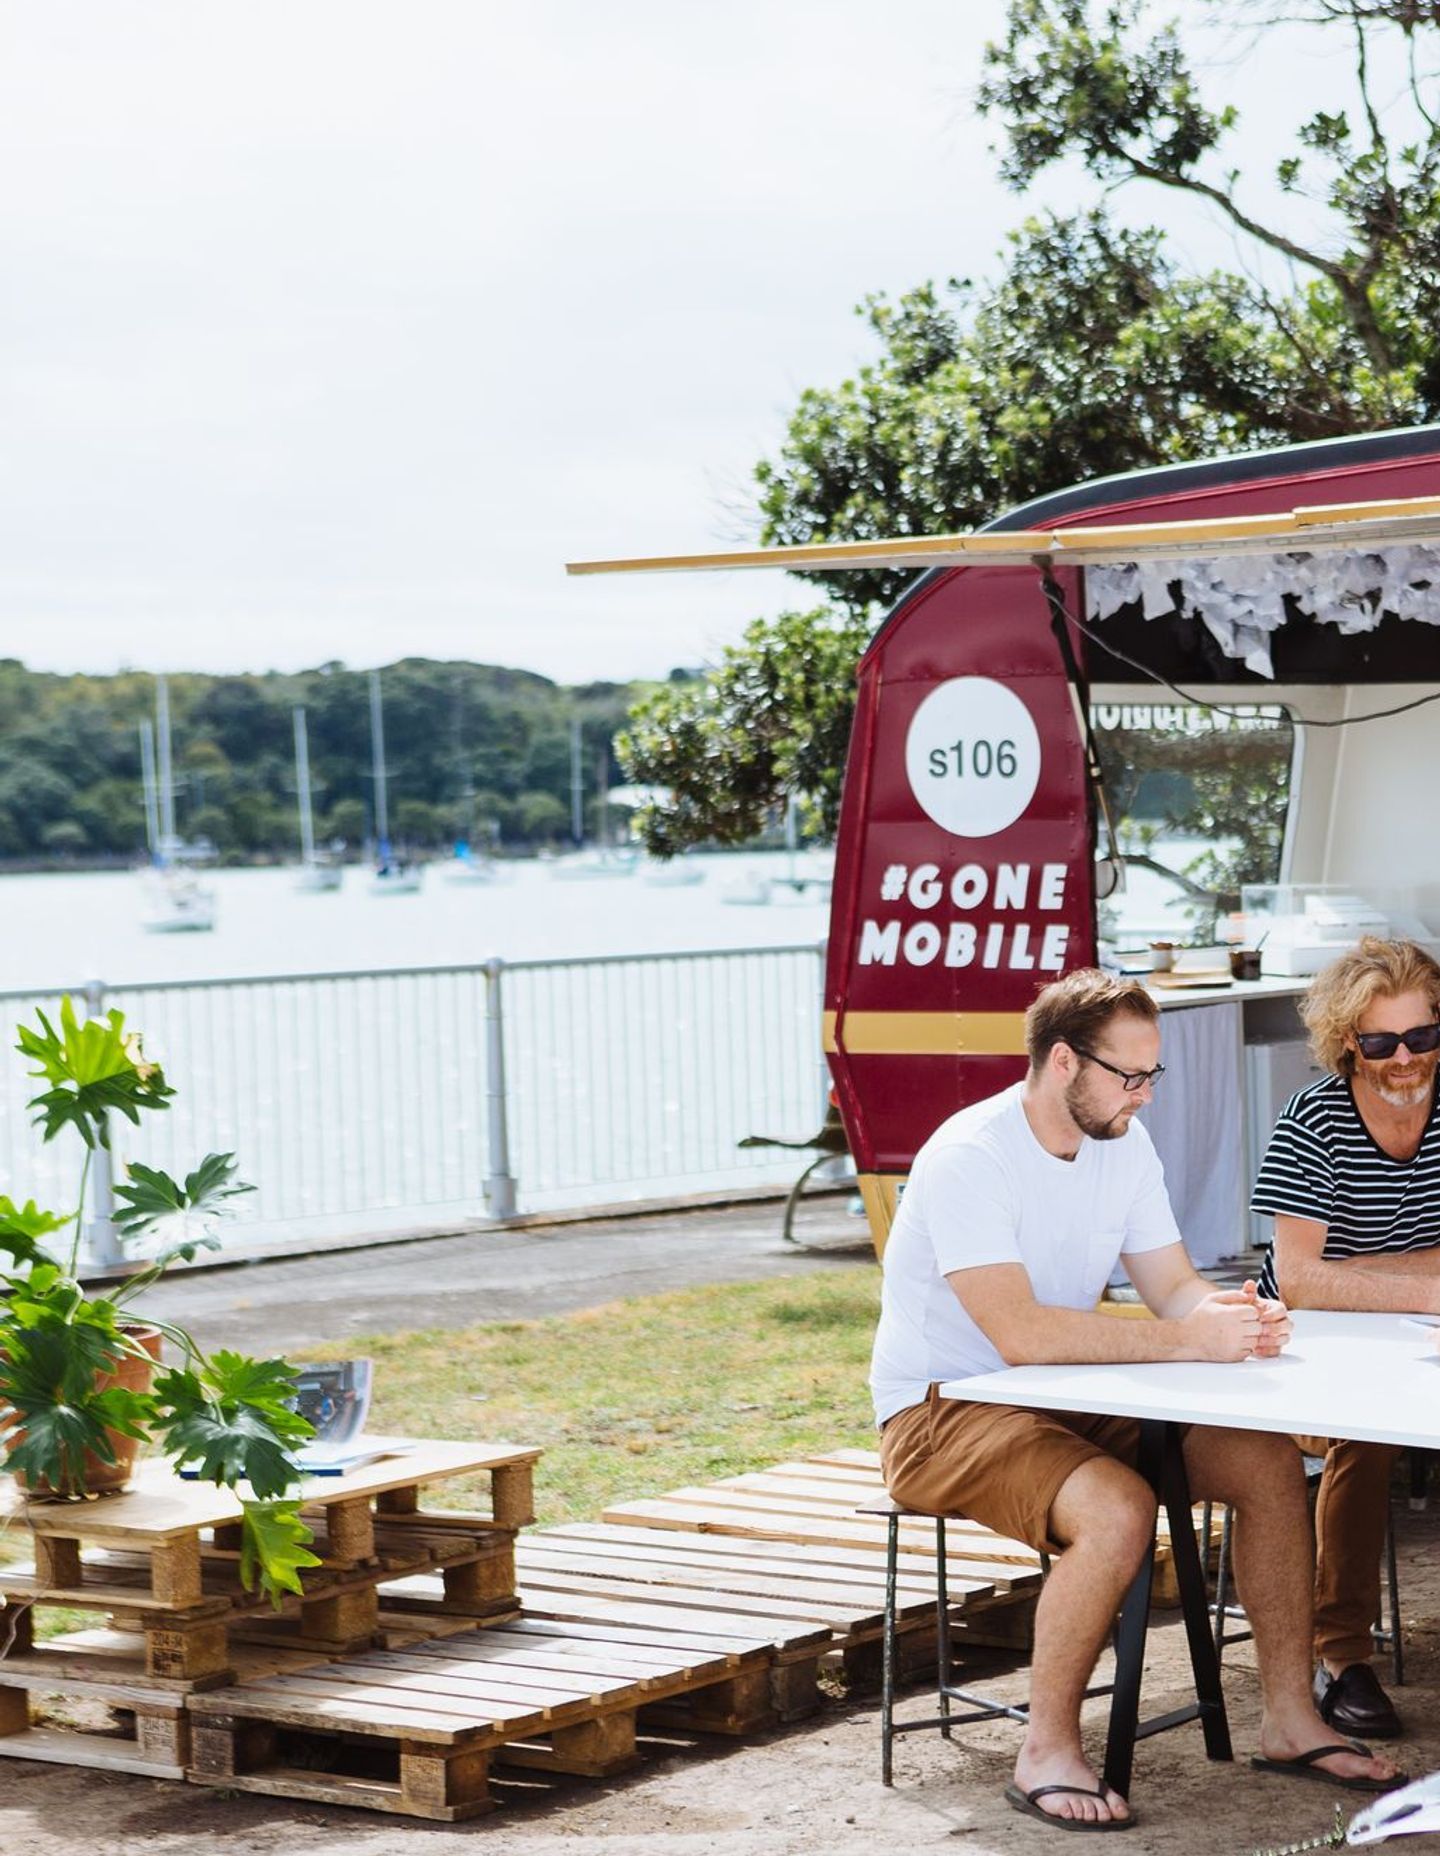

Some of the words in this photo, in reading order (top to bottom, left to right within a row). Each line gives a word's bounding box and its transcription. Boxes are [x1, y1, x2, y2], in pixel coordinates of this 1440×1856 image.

[928, 739, 1018, 779] s106
[880, 862, 1068, 910] #GONE
[858, 919, 1070, 970] MOBILE
